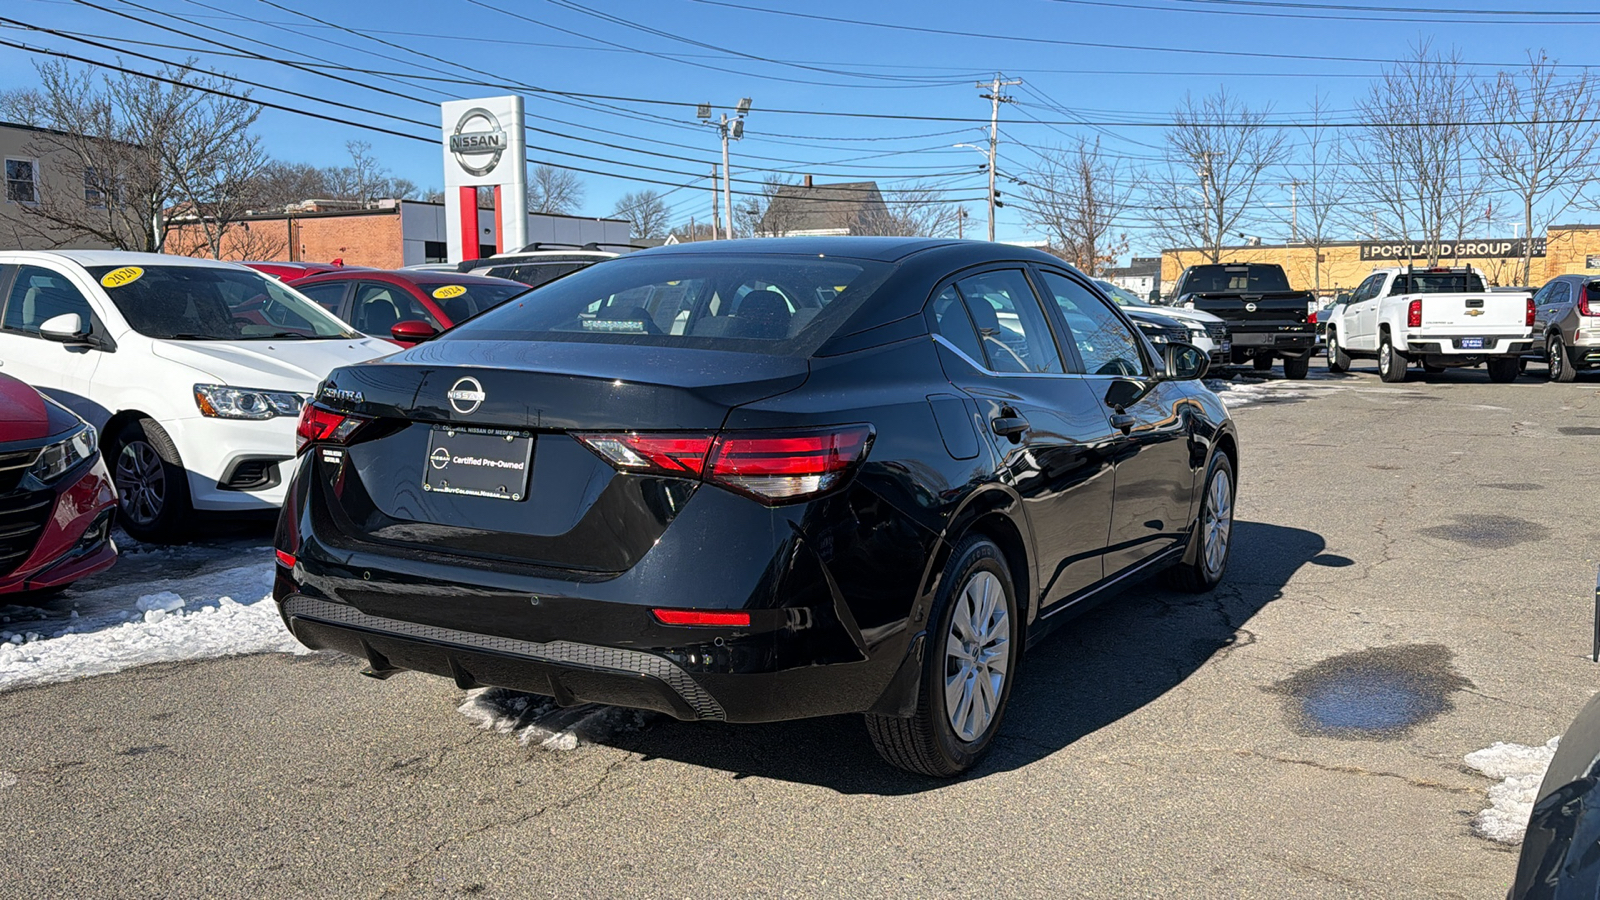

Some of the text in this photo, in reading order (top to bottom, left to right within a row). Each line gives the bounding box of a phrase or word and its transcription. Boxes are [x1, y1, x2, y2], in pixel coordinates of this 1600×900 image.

[452, 135, 499, 148] NISSAN
[1371, 243, 1452, 257] PORTLAND
[1454, 243, 1512, 255] GROUP
[108, 268, 136, 284] 2020
[438, 286, 462, 297] 2024
[448, 390, 485, 401] NISSAN
[453, 456, 524, 470] Certified Pre-Owned
